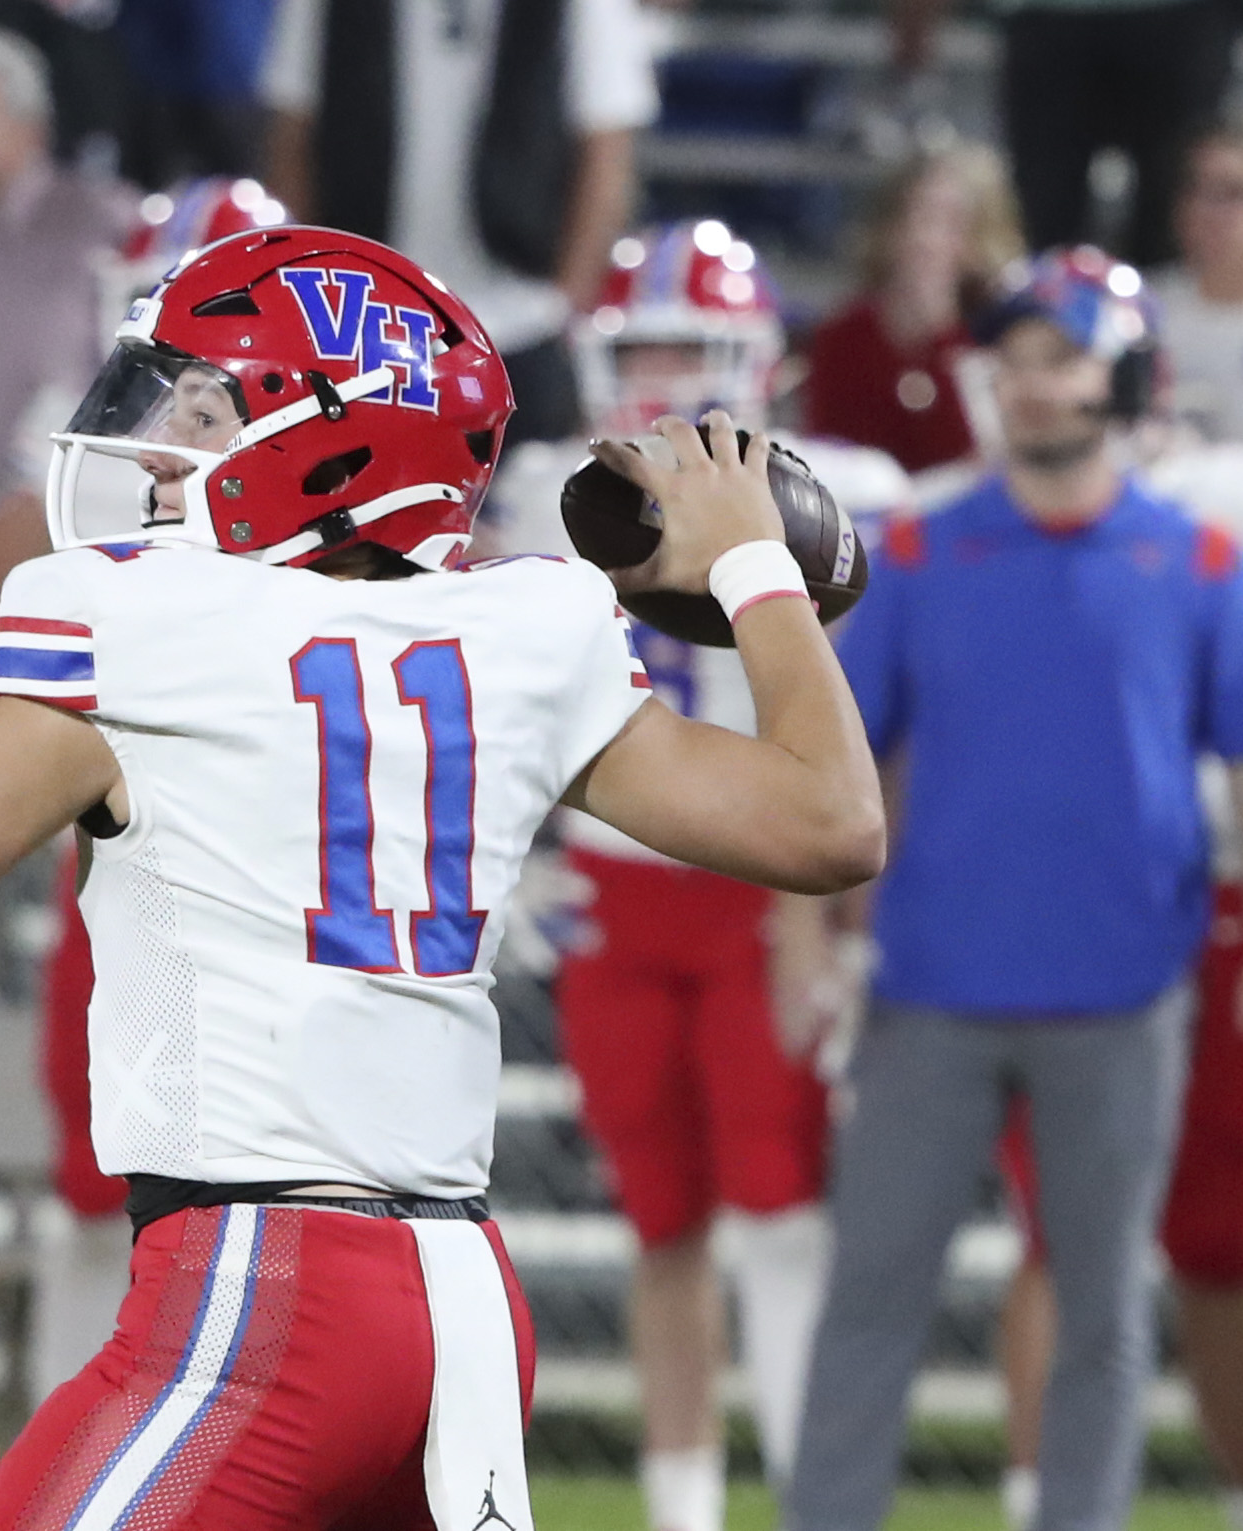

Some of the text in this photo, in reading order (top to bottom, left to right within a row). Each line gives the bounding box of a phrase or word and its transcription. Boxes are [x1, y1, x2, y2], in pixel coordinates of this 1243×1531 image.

[278, 267, 440, 415] VH
[837, 533, 852, 579] VH
[289, 636, 489, 977] 11
